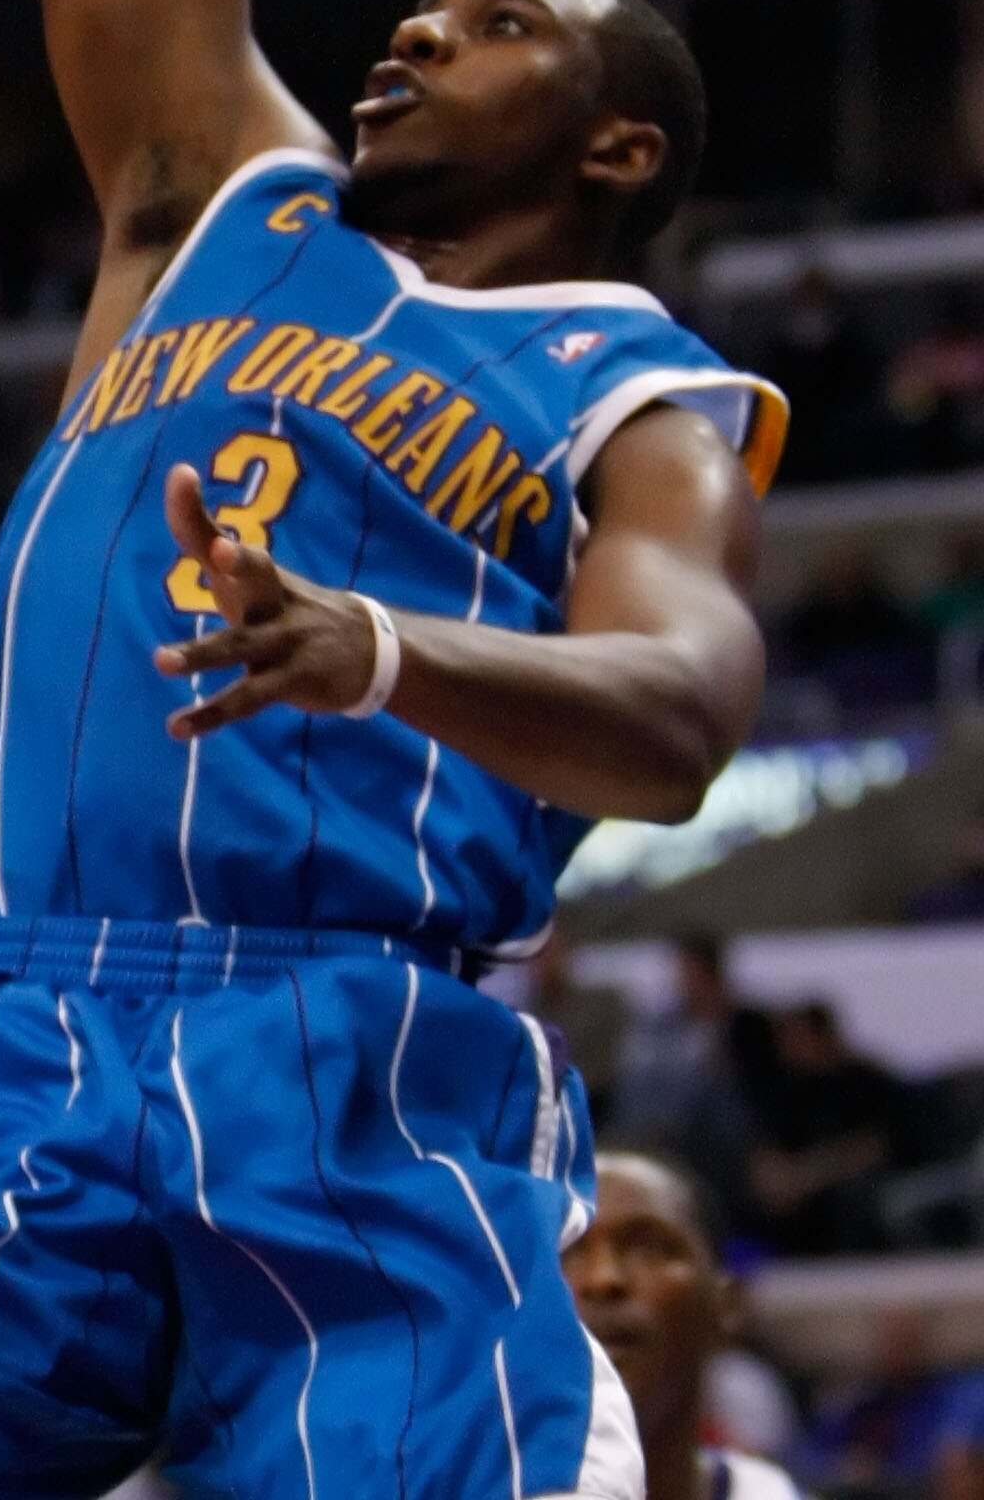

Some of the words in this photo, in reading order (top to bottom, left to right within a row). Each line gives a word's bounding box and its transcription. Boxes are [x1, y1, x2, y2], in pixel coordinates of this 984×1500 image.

[266, 192, 330, 233] C
[60, 317, 256, 441] NEW
[225, 323, 551, 561] ORLEANS
[163, 430, 302, 615] 3
